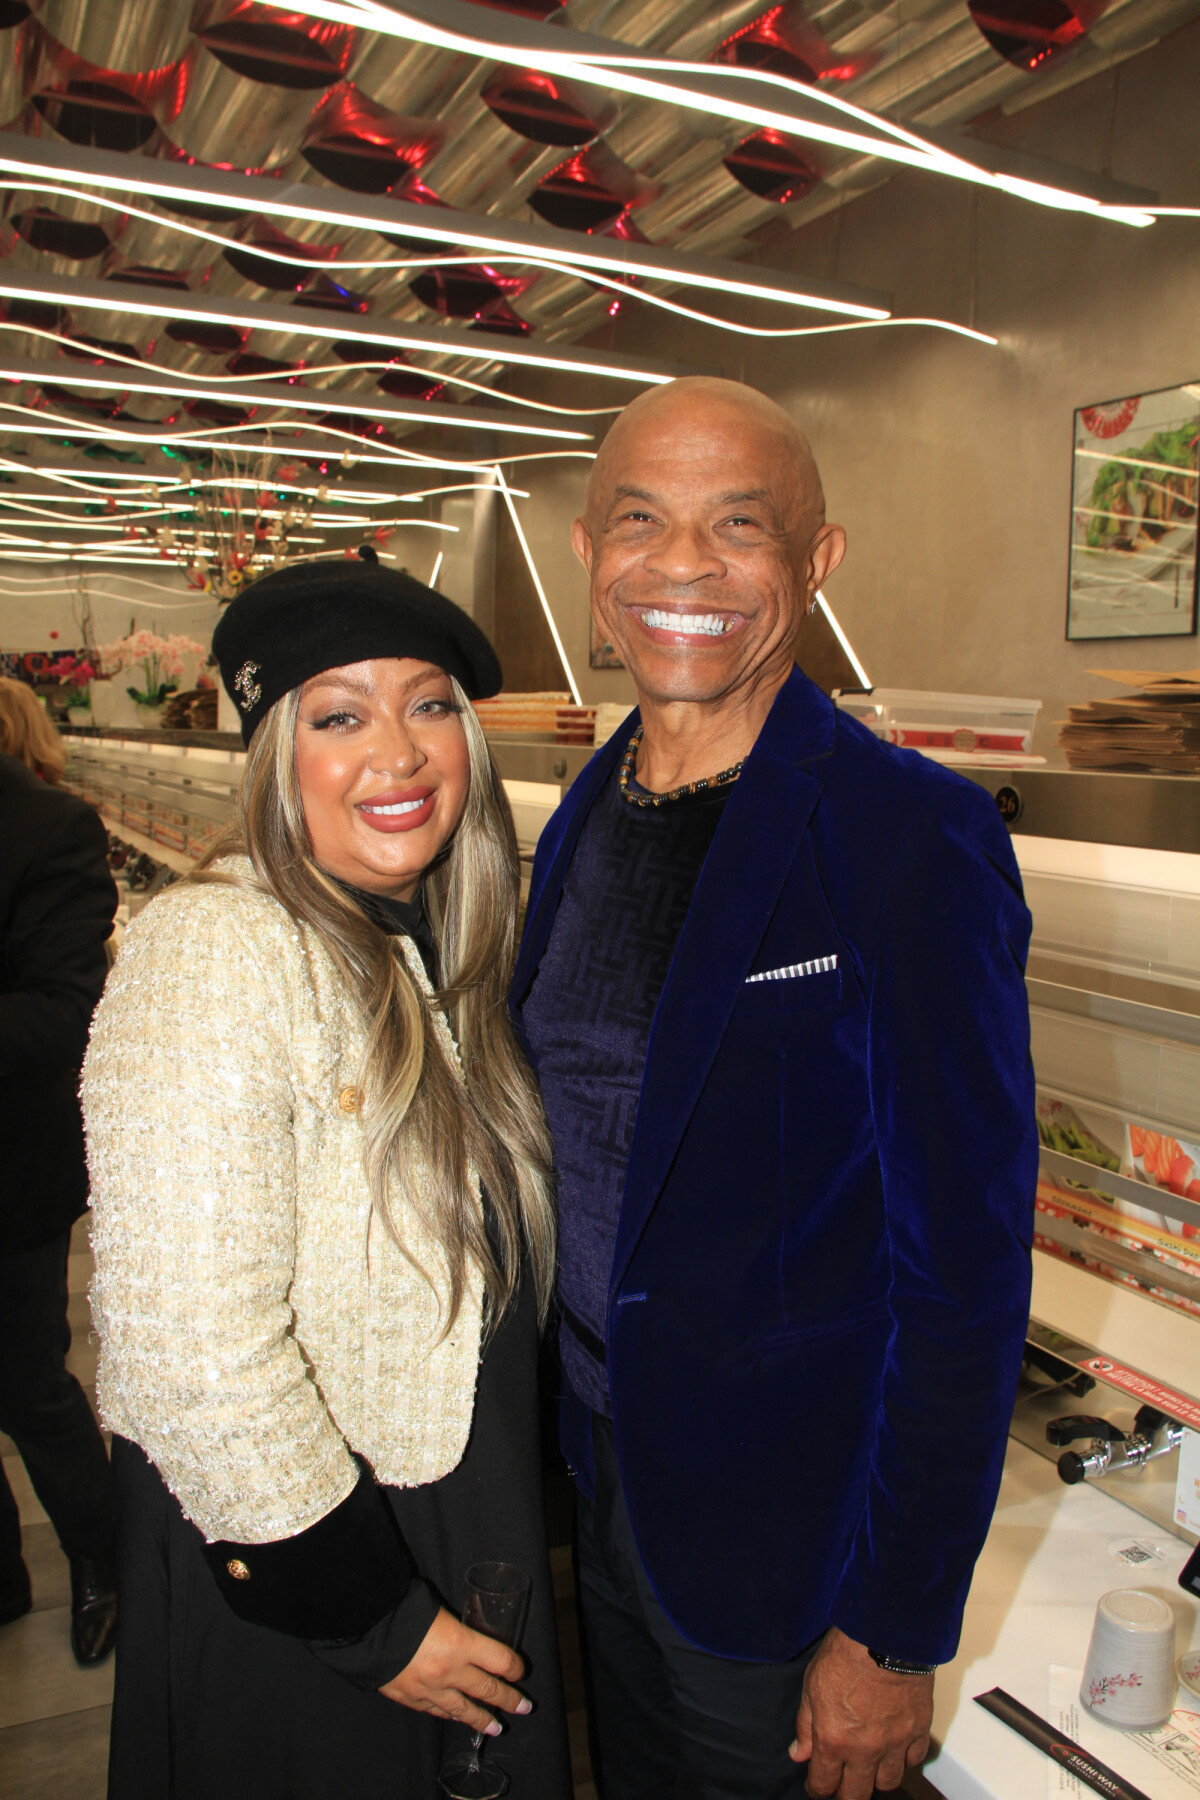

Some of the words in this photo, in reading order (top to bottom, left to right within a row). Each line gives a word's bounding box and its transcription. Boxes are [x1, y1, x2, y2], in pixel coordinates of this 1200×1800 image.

[1000, 796, 1015, 813] 26
[1106, 1372, 1135, 1387] METTRE
[1142, 1391, 1163, 1402] MAIN
[1161, 1401, 1178, 1410] SUR
[1114, 1369, 1157, 1390] ATTENTION
[1158, 1391, 1183, 1404] MERCI
[1070, 1755, 1099, 1777] SUSHI
[1097, 1774, 1119, 1791] WAY
